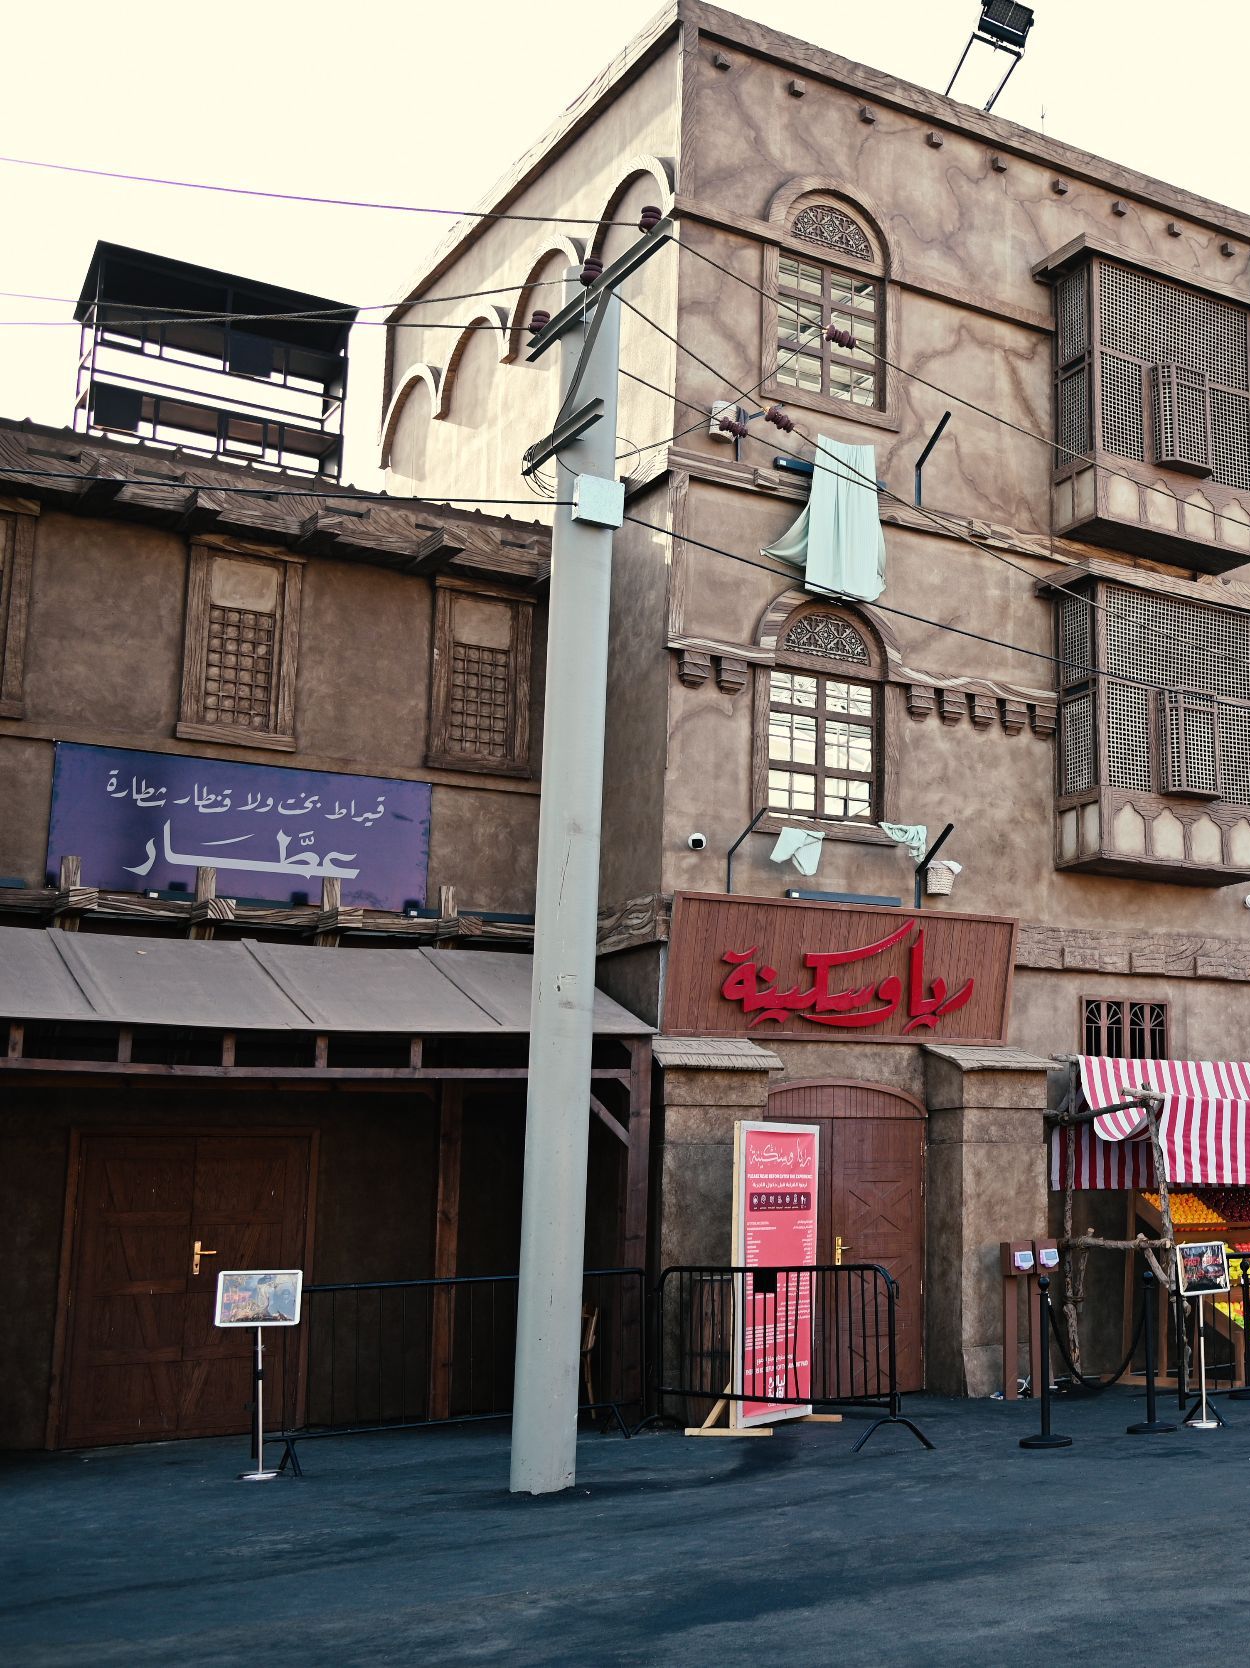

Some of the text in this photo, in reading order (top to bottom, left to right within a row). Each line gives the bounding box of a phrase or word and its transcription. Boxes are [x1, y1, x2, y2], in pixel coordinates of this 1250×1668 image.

[106, 769, 386, 827] قيراط بخت ولا قنطار شطارة
